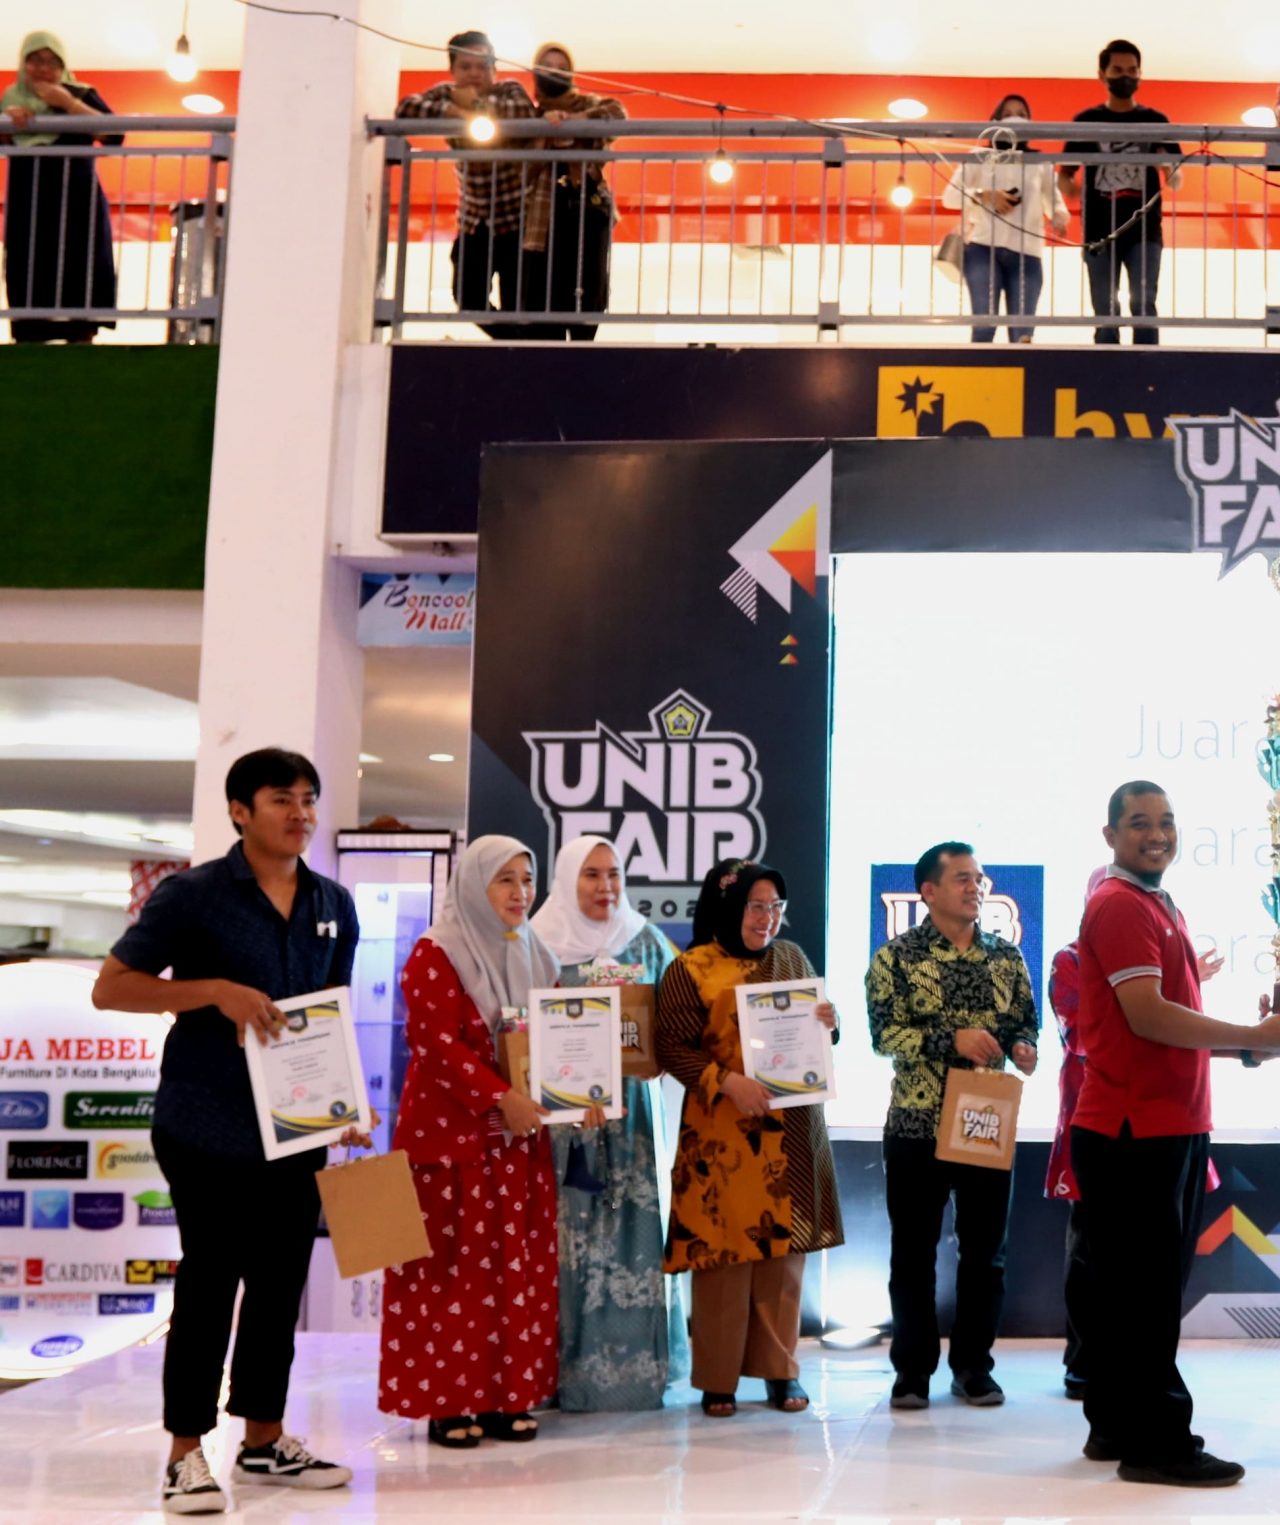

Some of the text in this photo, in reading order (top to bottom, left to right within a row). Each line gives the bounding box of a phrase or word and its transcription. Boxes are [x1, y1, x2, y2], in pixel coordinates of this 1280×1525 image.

[403, 609, 466, 631] Mall
[544, 740, 751, 807] UNIB
[46, 1037, 157, 1060] MEBEL
[0, 1066, 51, 1078] Furniture
[73, 1066, 98, 1078] Kota
[102, 1066, 157, 1080] Bengkulu
[963, 1109, 1000, 1128] UNIB
[963, 1122, 1000, 1142] FAIR
[45, 1263, 121, 1283] CARDIVA
